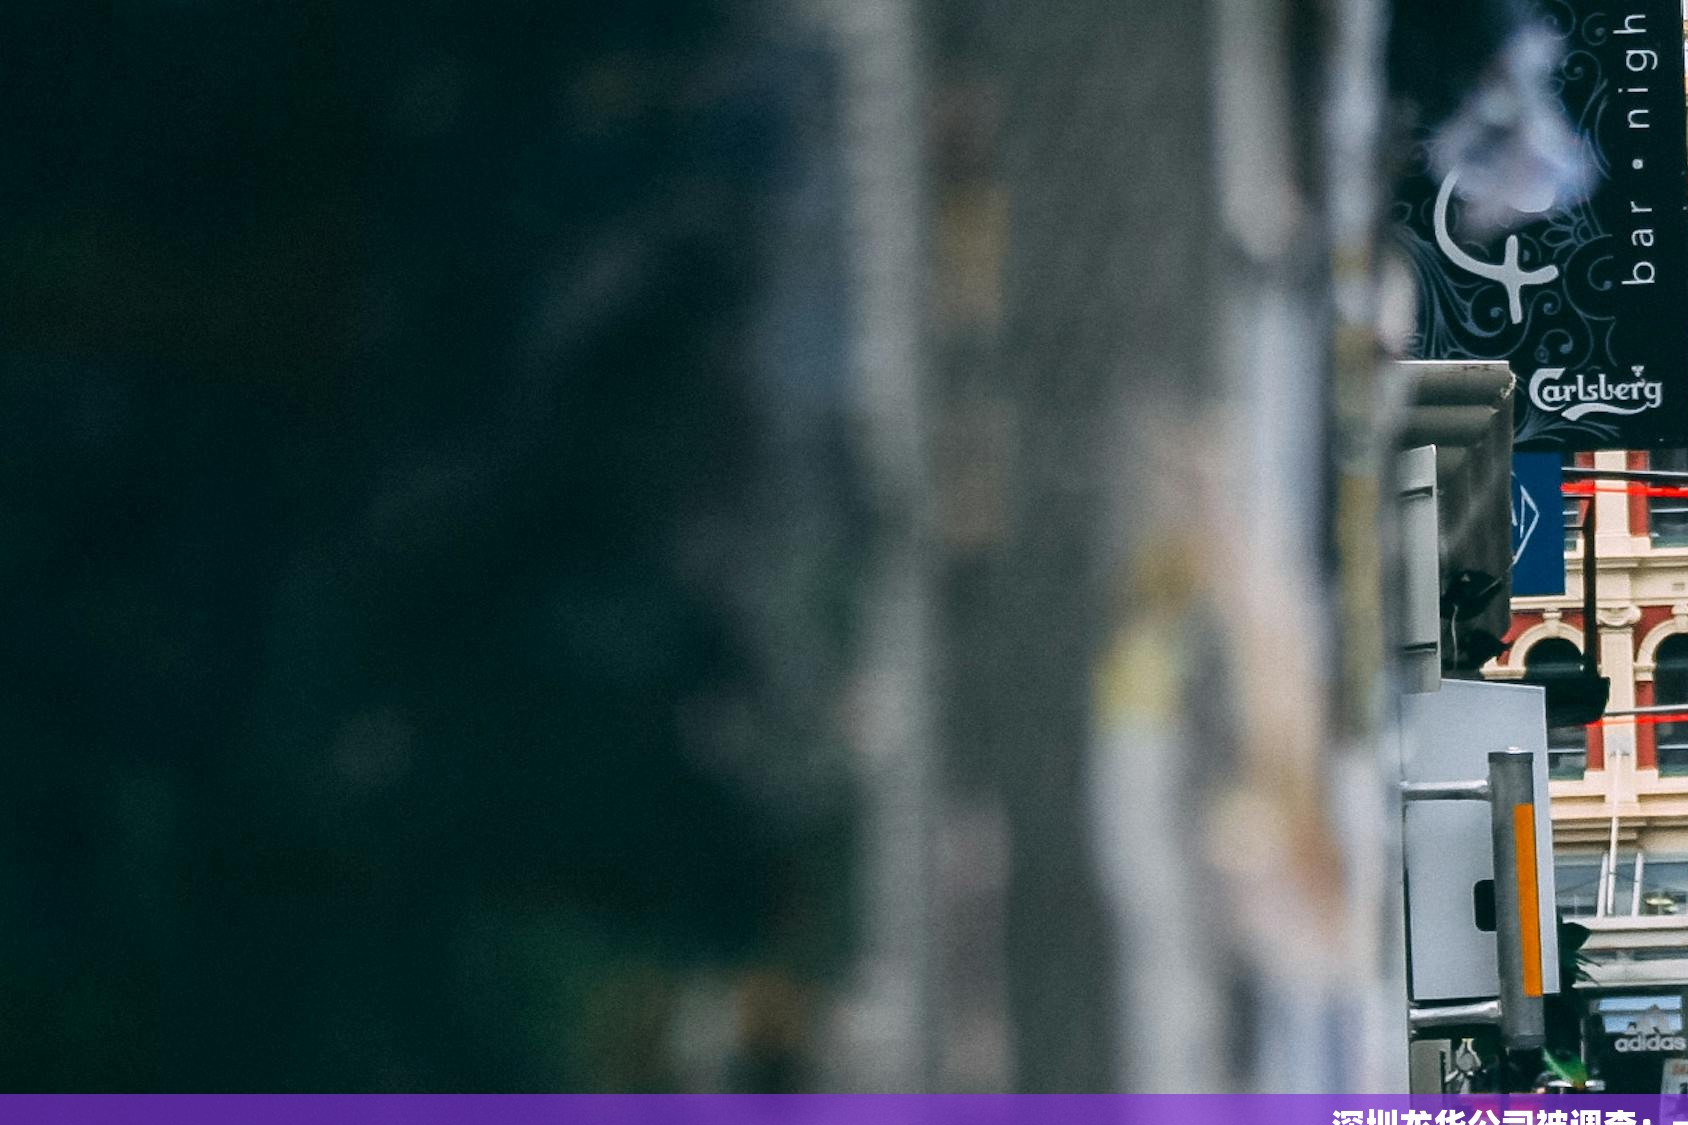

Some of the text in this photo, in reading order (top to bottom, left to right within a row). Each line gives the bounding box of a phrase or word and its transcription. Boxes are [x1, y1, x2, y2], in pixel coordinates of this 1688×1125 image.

[1621, 200, 1656, 285] bar
[1528, 365, 1663, 413] Carlsberg
[1614, 1031, 1687, 1053] adidas
